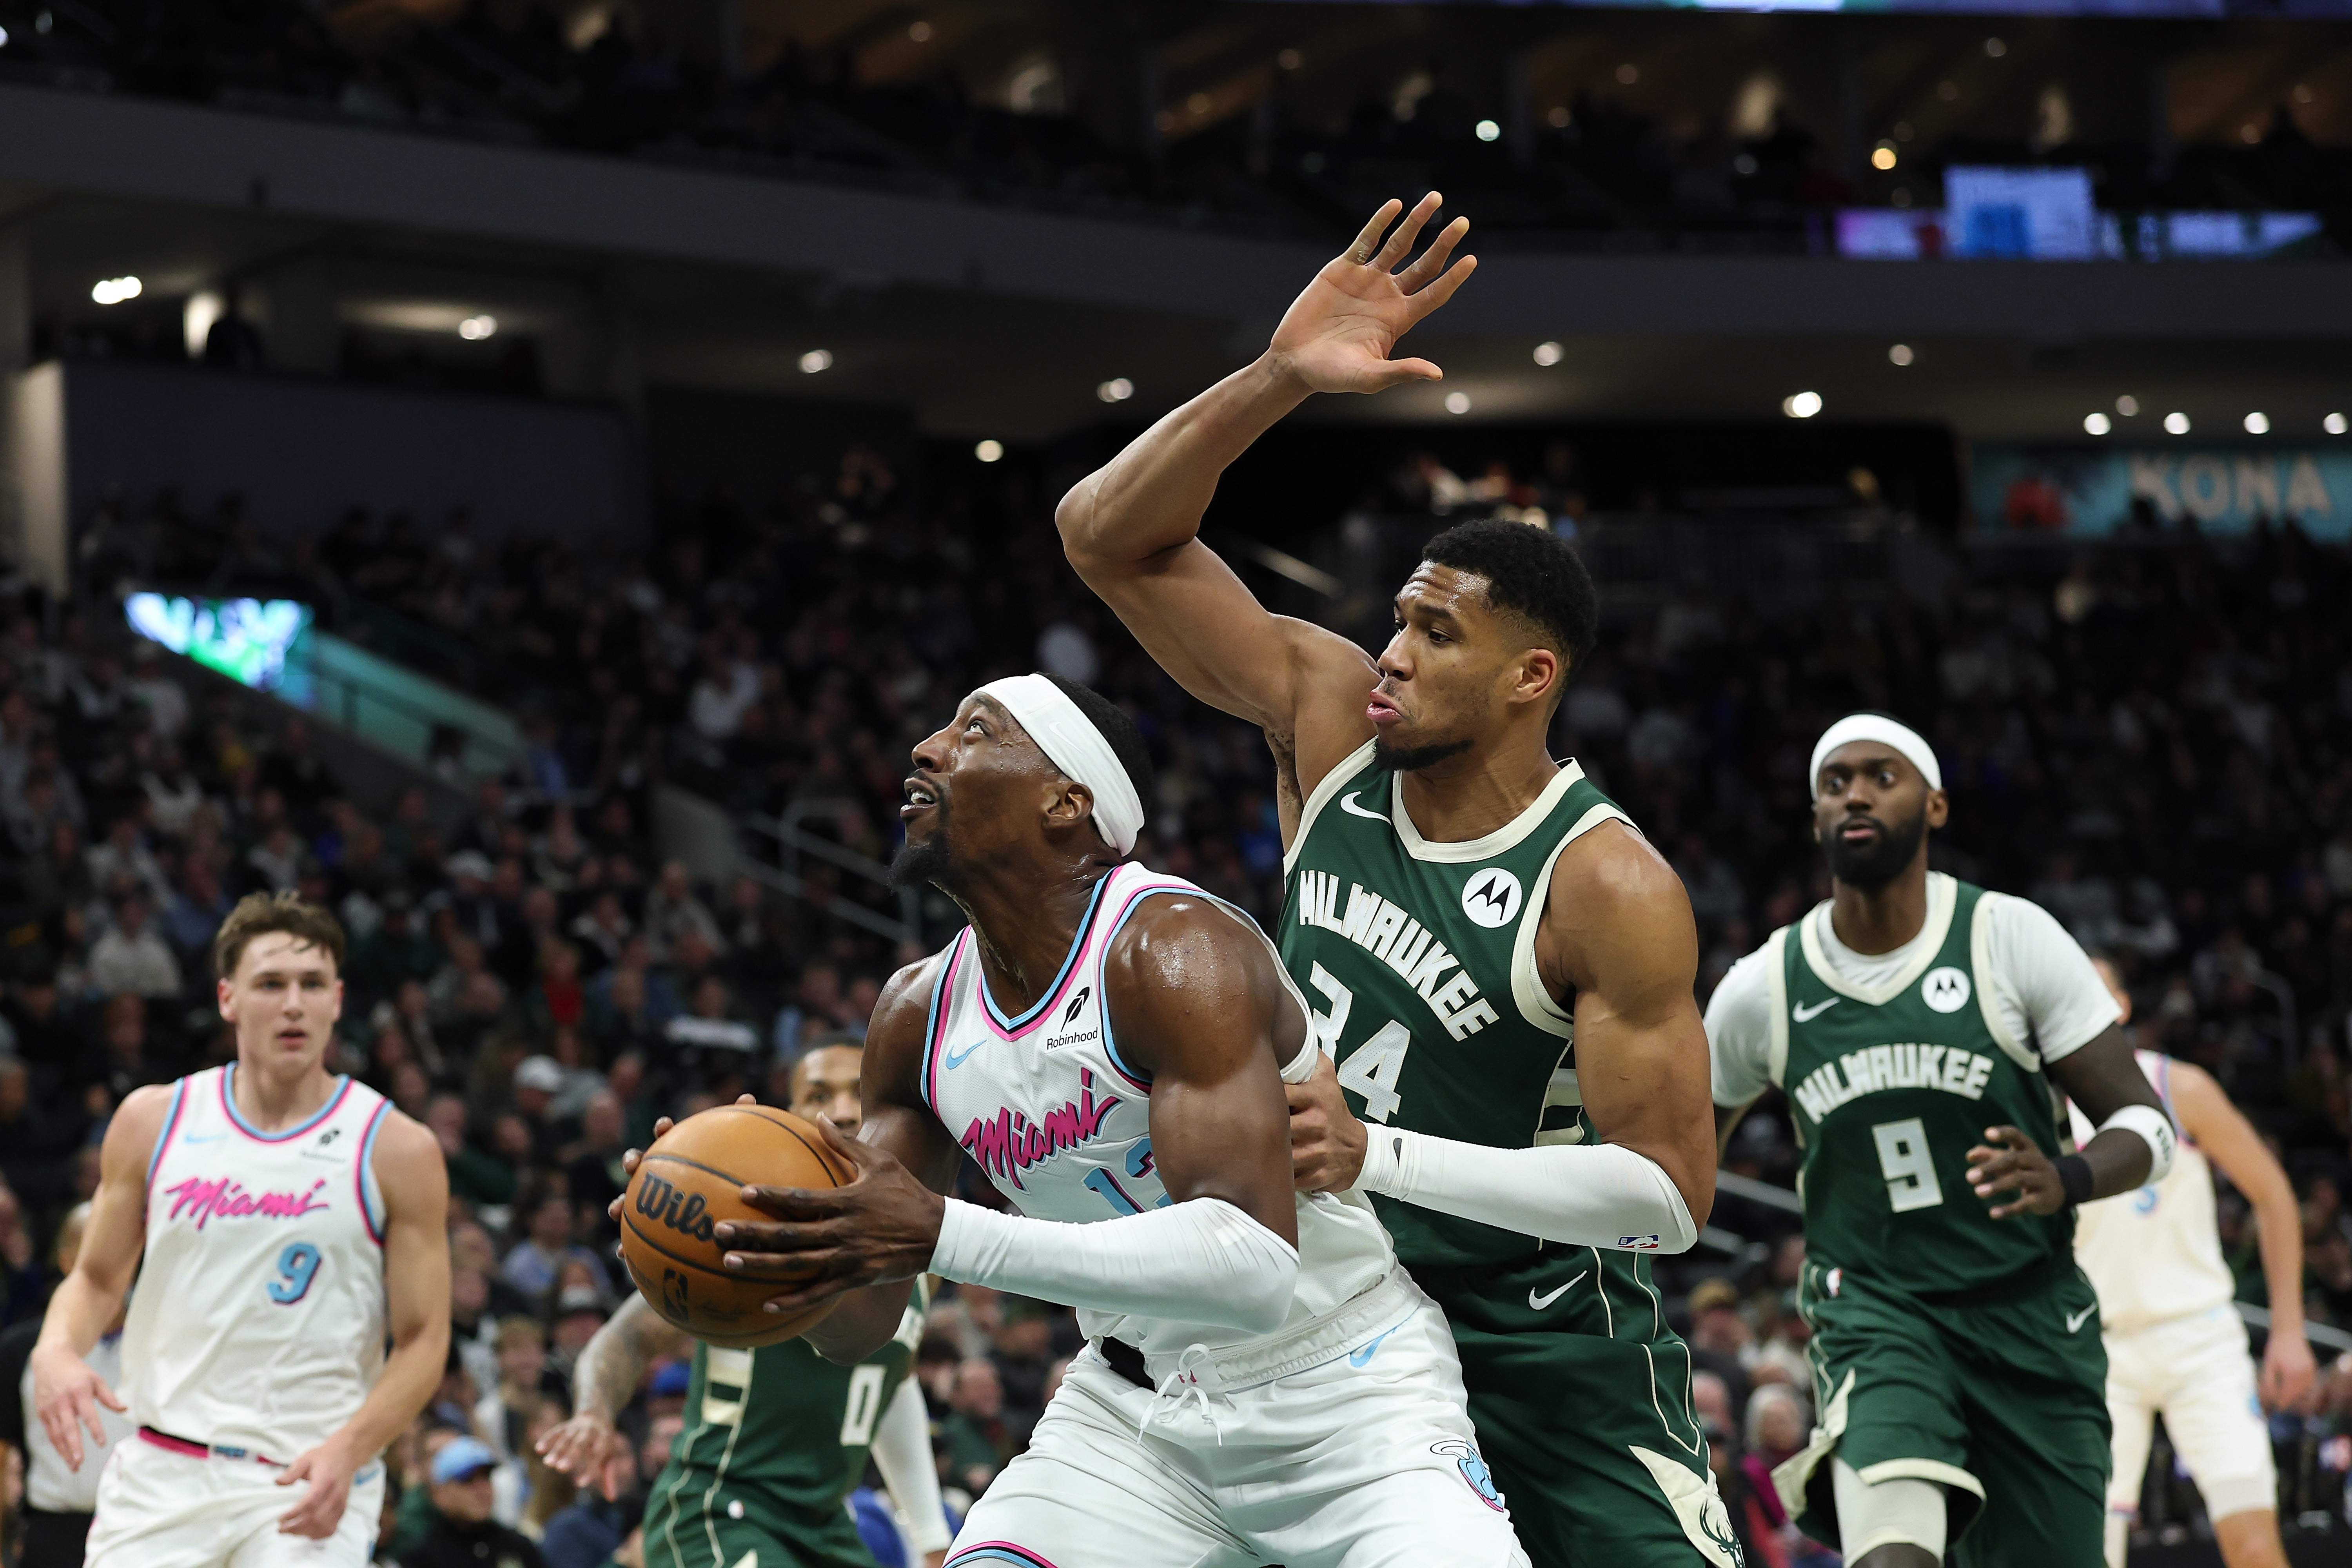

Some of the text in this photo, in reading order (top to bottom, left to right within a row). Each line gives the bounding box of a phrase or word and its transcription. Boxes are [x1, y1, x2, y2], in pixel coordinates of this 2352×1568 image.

[1299, 870, 1499, 1042] MILWAUKEE
[1047, 1026, 1098, 1050] Robinhood
[1794, 1043, 1994, 1124] MILWAUKEE
[960, 1067, 1123, 1192] Miami
[1872, 1117, 1943, 1213] 9
[165, 1178, 330, 1230] Miami
[635, 1170, 714, 1242] Wils
[267, 1241, 321, 1306] 9
